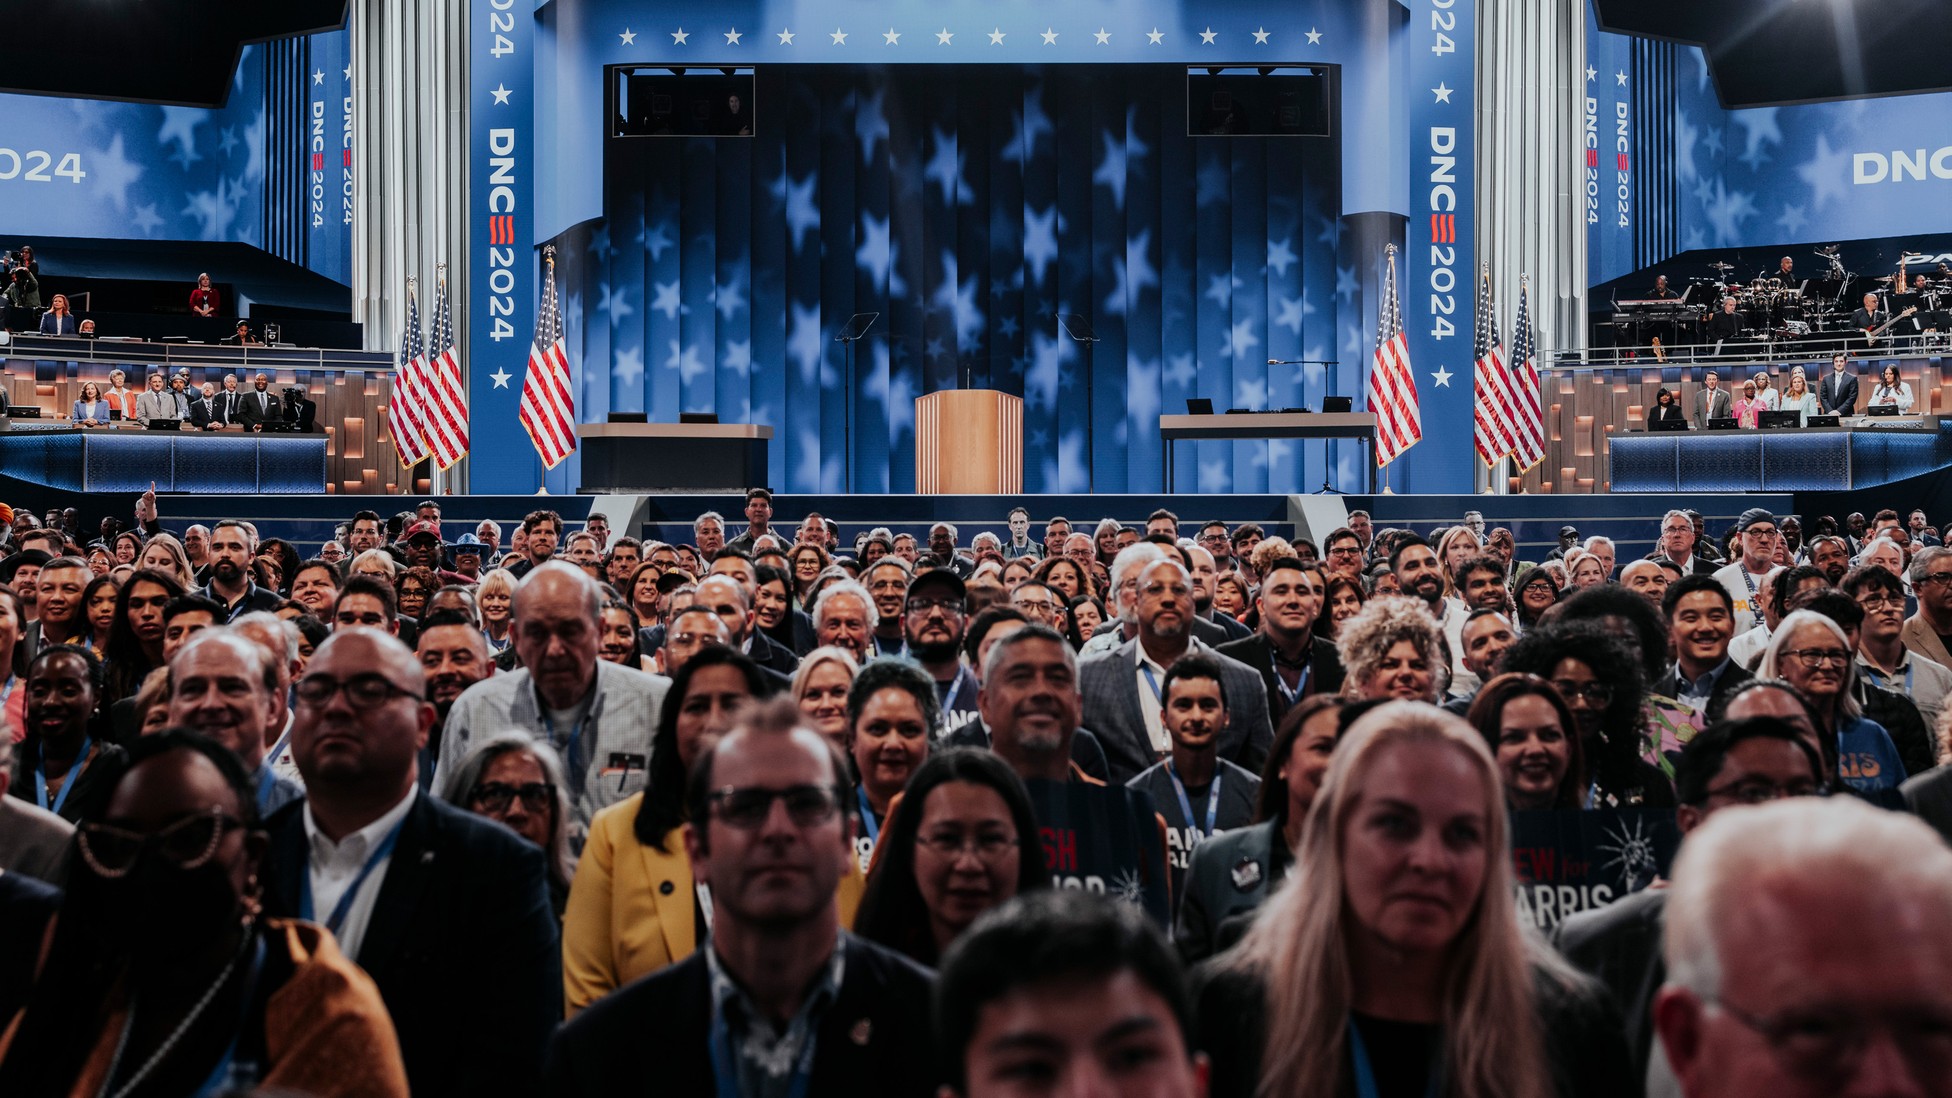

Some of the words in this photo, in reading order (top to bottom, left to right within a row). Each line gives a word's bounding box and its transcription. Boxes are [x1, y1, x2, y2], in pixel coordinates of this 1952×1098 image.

[313, 101, 324, 152] DNC
[1586, 97, 1597, 149] DNC
[1616, 102, 1628, 153] DNC
[489, 128, 515, 213] DNC
[1430, 126, 1456, 212] DNC
[1587, 168, 1598, 225] 2024
[312, 172, 324, 228] 2024
[1617, 172, 1629, 228] 2024
[489, 247, 515, 342] 2024
[1430, 245, 1456, 341] 2024
